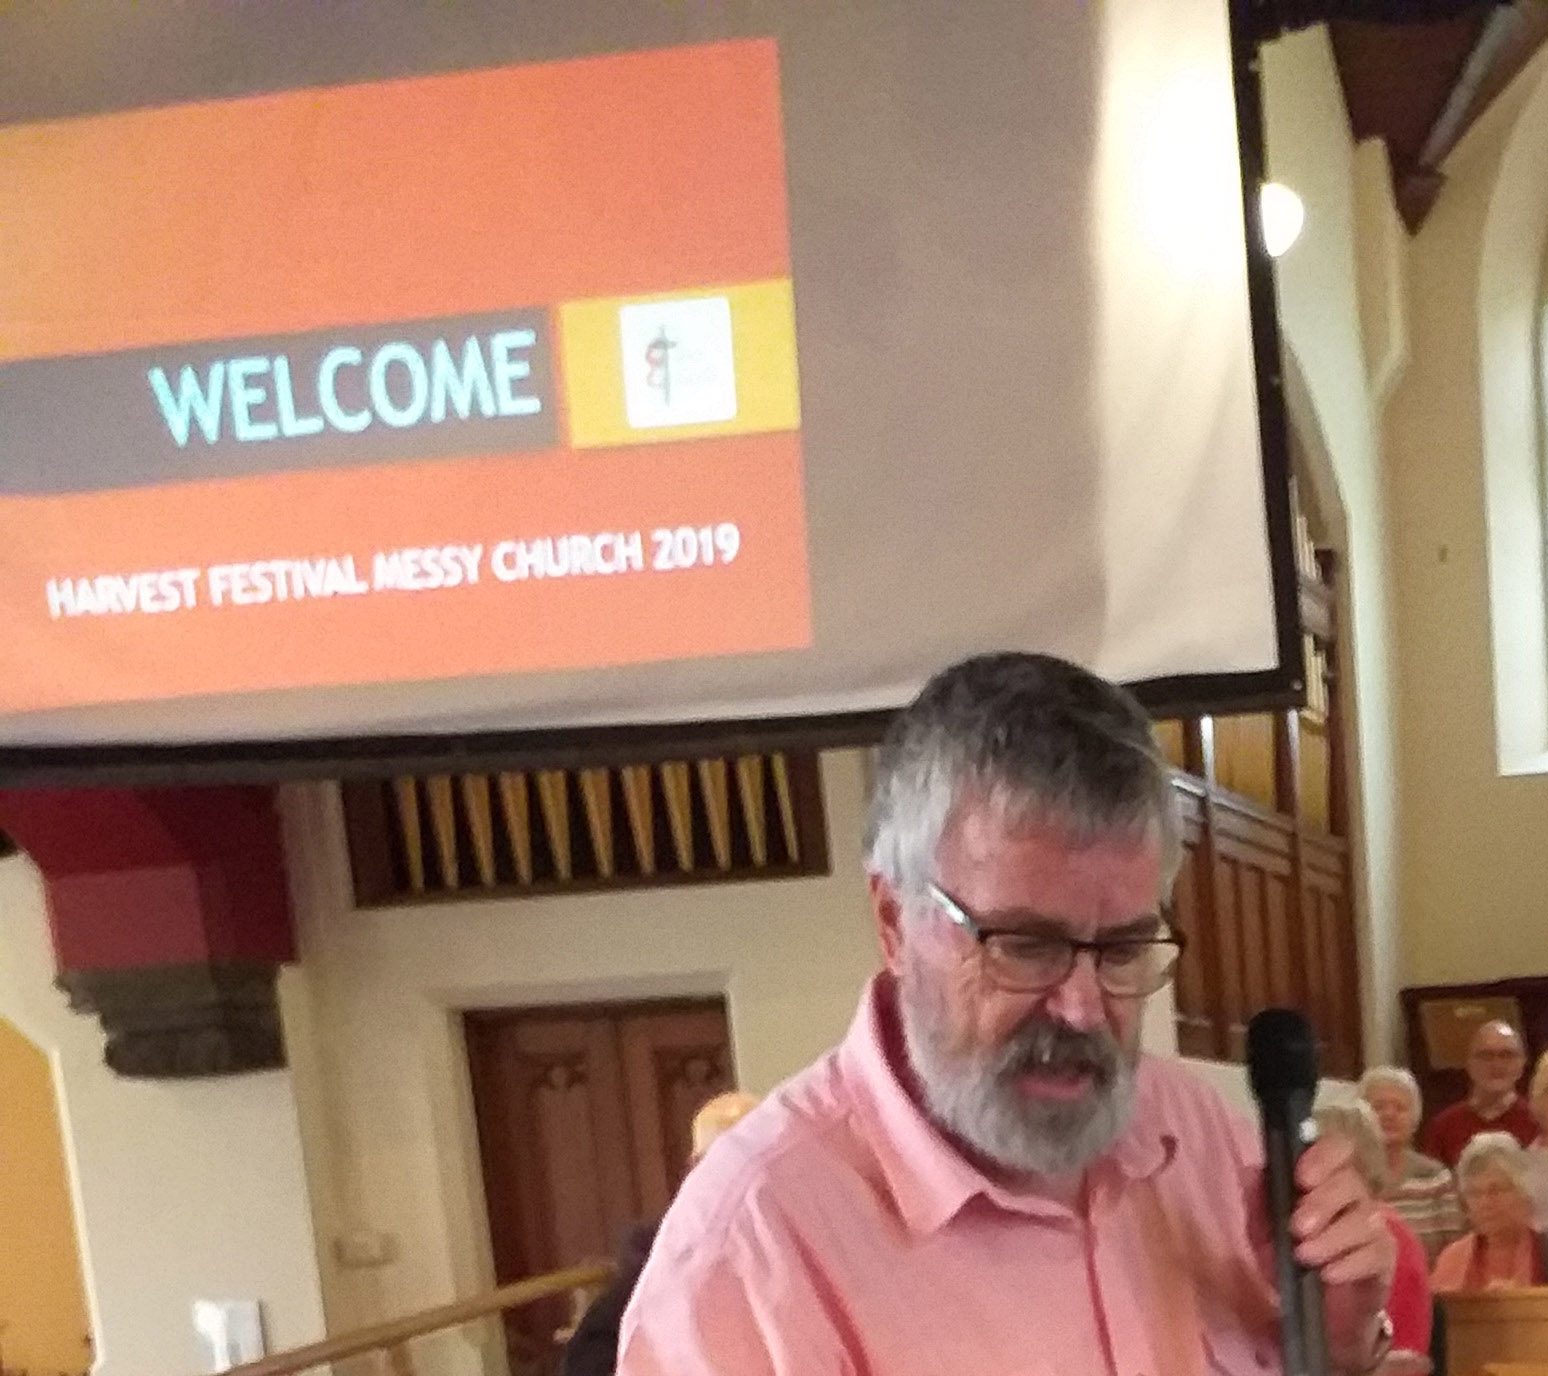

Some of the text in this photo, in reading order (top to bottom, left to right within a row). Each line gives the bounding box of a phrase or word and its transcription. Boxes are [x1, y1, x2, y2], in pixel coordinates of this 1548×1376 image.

[147, 330, 542, 448] WELCOME
[46, 523, 740, 620] HARVEST FESTIVAL MESSY CHURCH 2019
